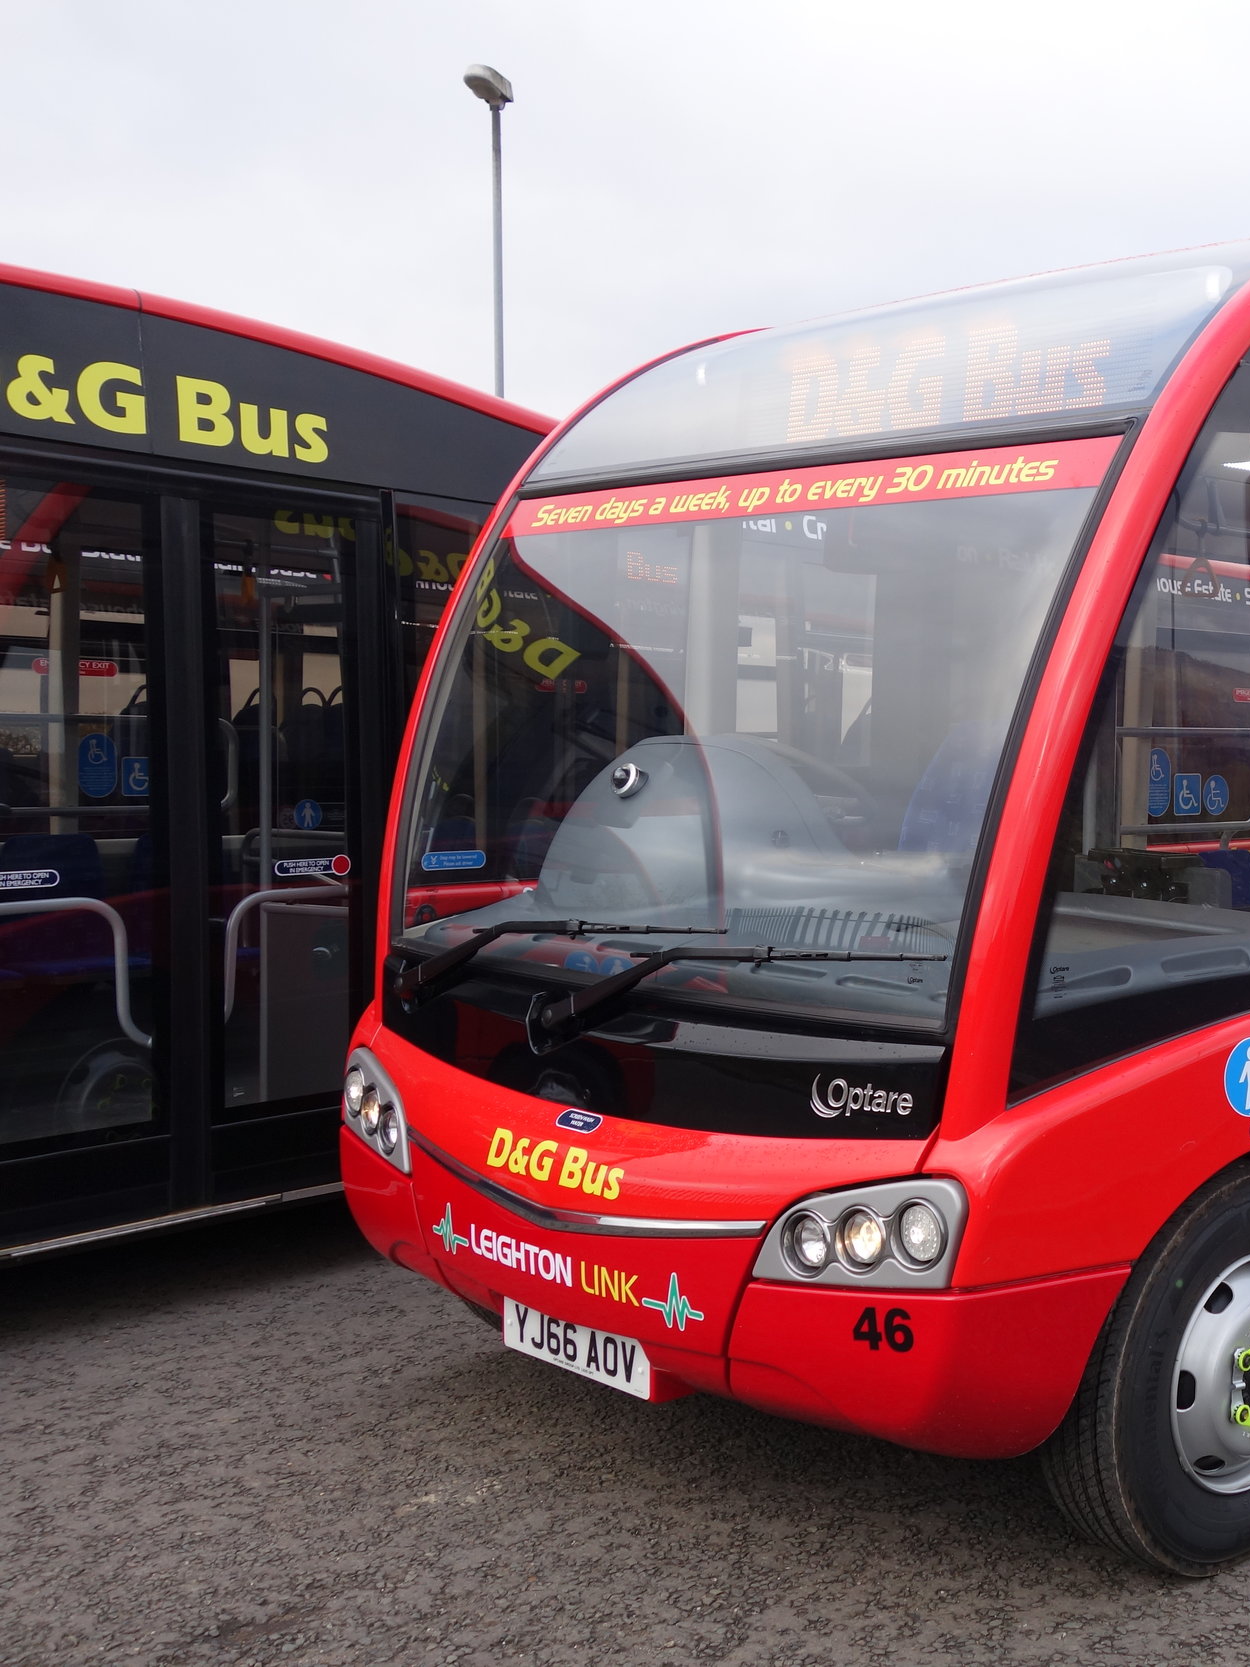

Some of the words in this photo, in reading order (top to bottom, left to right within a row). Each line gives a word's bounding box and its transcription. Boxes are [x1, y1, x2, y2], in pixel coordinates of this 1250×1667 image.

[175, 375, 328, 464] Bus
[786, 336, 946, 441] D&G
[963, 326, 1112, 421] Bus
[531, 504, 593, 527] Seven
[595, 497, 648, 524] days
[648, 497, 666, 515] a
[669, 485, 732, 513] week,
[738, 486, 770, 512] up
[775, 478, 802, 502] to
[807, 475, 884, 503] every
[885, 464, 935, 494] 30
[936, 456, 1060, 490] minutes
[827, 1078, 913, 1117] Optare
[486, 1127, 559, 1181] D&G
[558, 1146, 625, 1200] Bus
[470, 1223, 573, 1288] LEIGHTON
[580, 1261, 640, 1307] LINK
[515, 1304, 577, 1362] YJ66
[586, 1330, 636, 1384] AOV
[853, 1306, 914, 1352] 46
